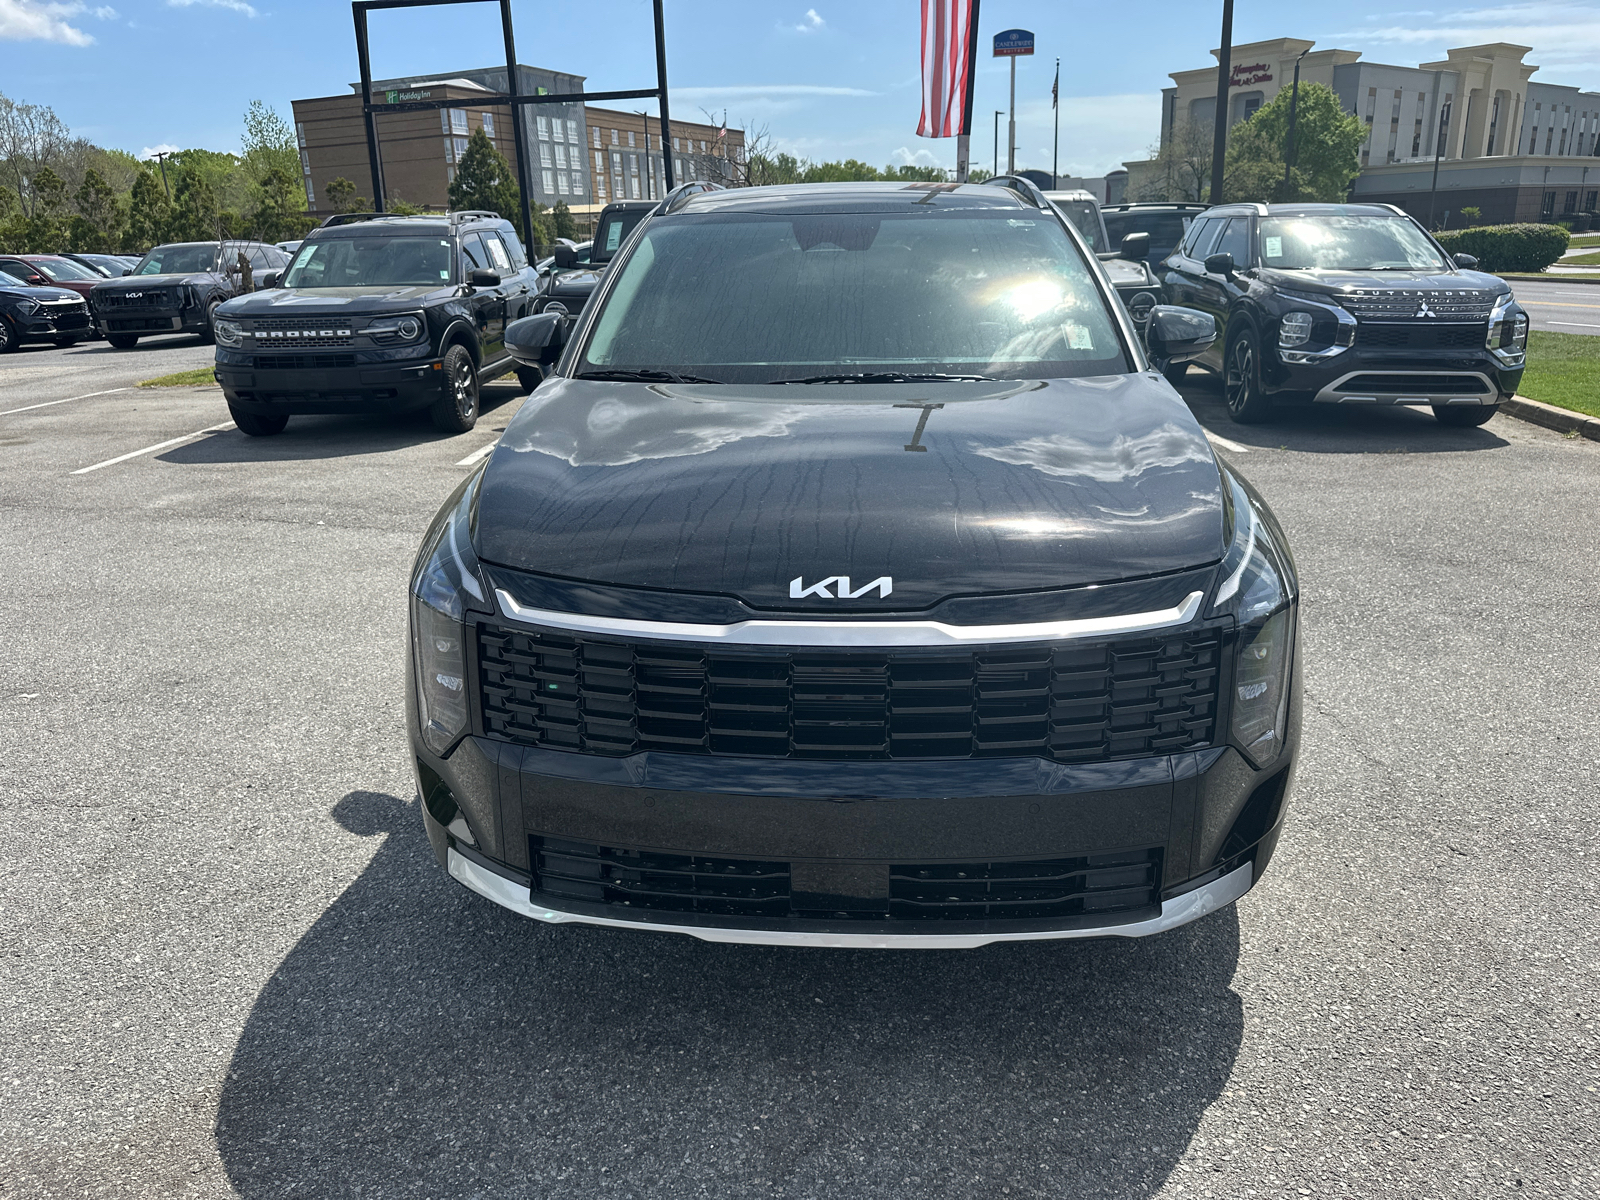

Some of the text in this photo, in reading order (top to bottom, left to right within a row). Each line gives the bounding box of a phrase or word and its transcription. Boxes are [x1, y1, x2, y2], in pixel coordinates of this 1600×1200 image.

[1250, 74, 1272, 84] Suites
[399, 91, 421, 100] Holiday
[421, 90, 431, 98] Inn
[254, 329, 352, 338] BRONCO
[789, 575, 893, 599] KIA
